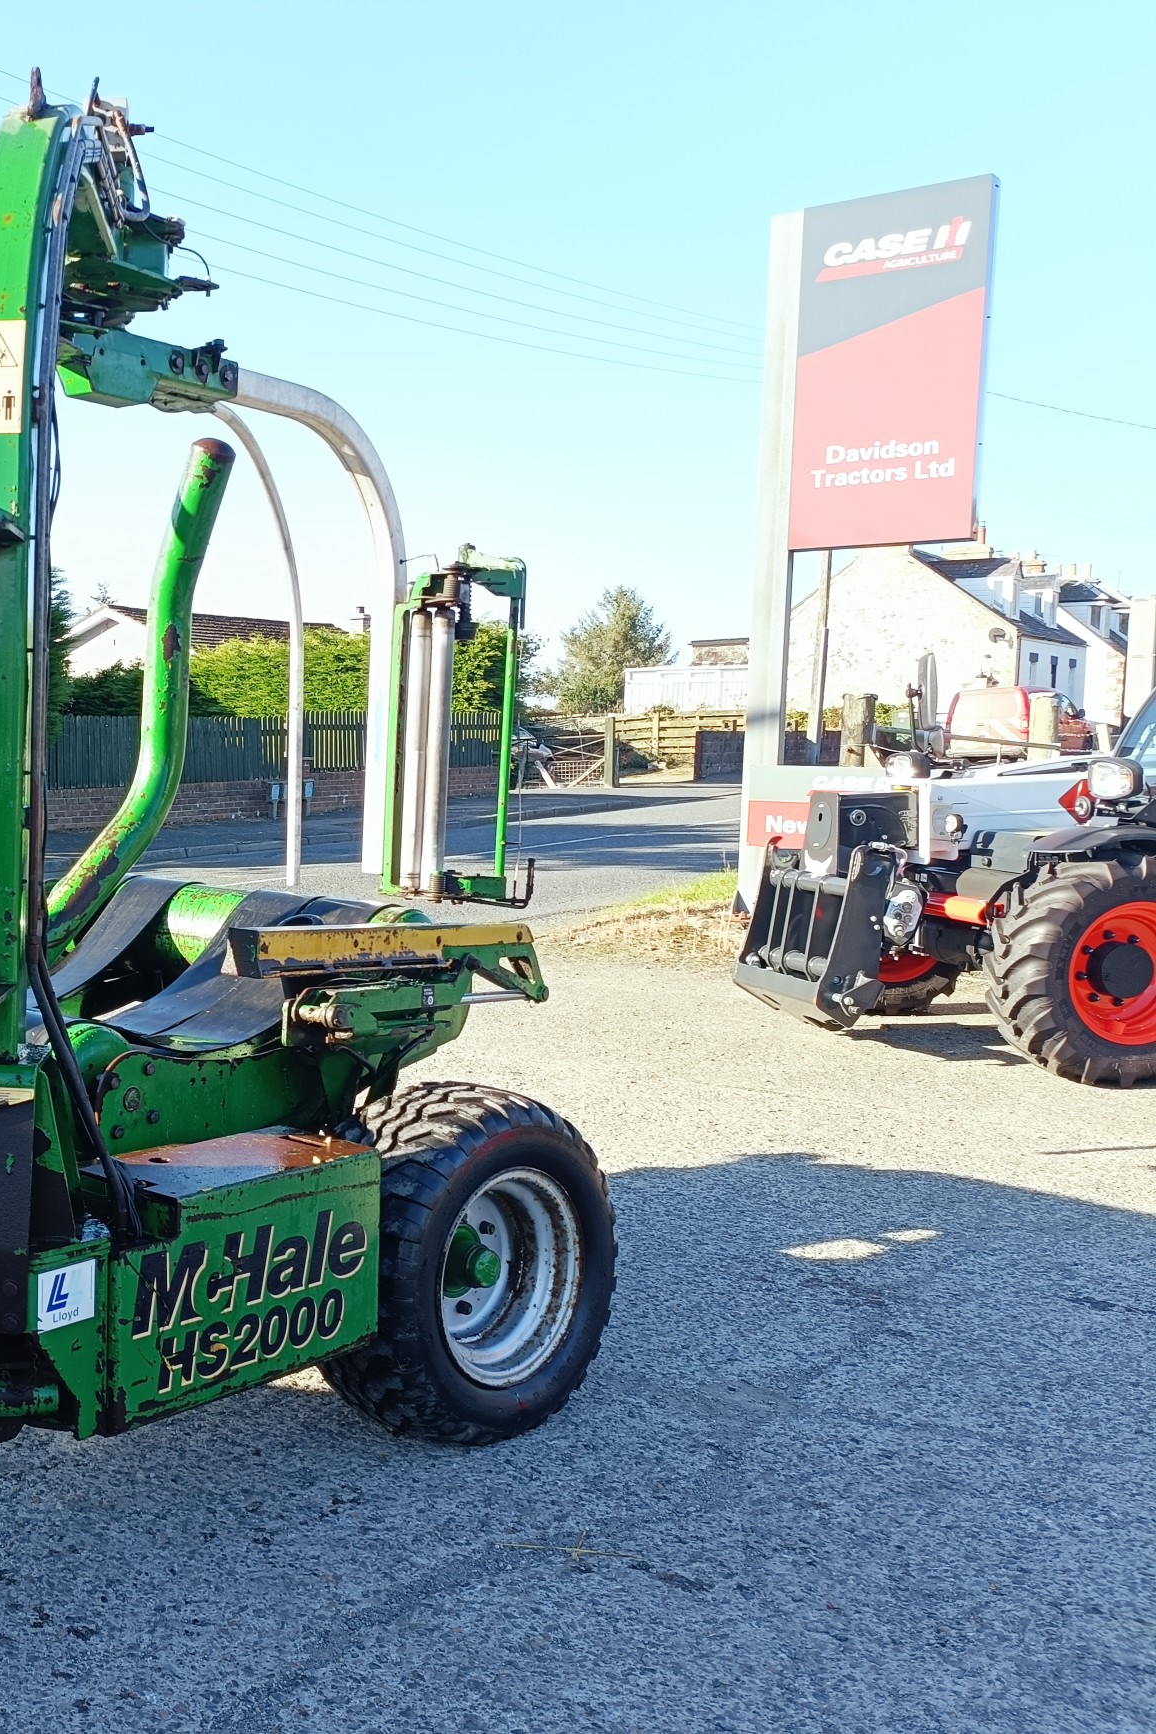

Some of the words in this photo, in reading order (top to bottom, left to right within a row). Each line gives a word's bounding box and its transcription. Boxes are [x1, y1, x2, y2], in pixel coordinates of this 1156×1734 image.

[824, 228, 932, 267] CASE
[882, 250, 958, 269] AGRICULTURE
[826, 440, 939, 464] Davidson
[810, 467, 907, 488] Tractors
[914, 457, 955, 479] Ltd
[811, 775, 874, 790] CASE
[132, 1209, 368, 1339] McHale
[53, 1306, 79, 1323] Lloyd
[158, 1289, 344, 1394] HS2000
